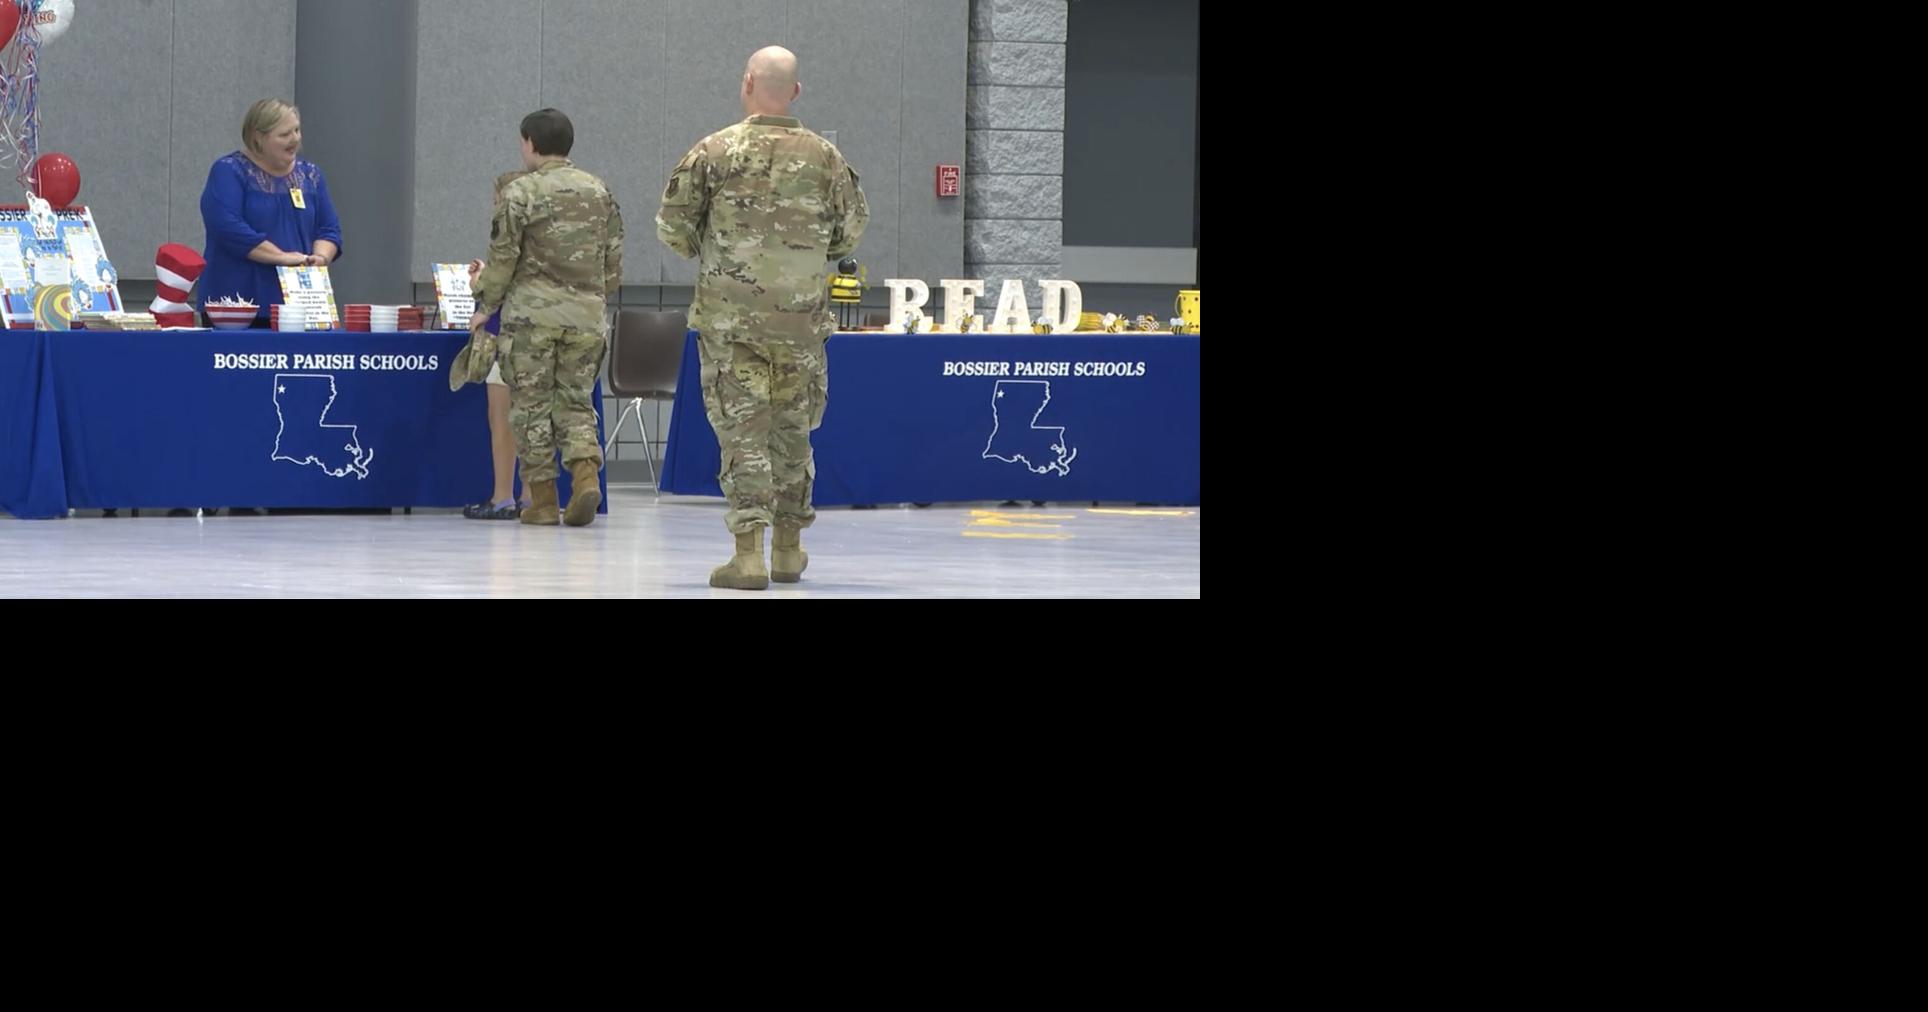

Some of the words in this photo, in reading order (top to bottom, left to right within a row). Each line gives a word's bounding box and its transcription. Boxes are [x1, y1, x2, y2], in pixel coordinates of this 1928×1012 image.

[884, 279, 1083, 333] READ
[214, 353, 289, 369] BOSSIER
[293, 354, 355, 370] PARISH
[359, 354, 439, 371] SCHOOLS
[943, 361, 1010, 376] BOSSIER
[1013, 361, 1071, 376] PARISH
[1074, 362, 1146, 377] SCHOOLS
